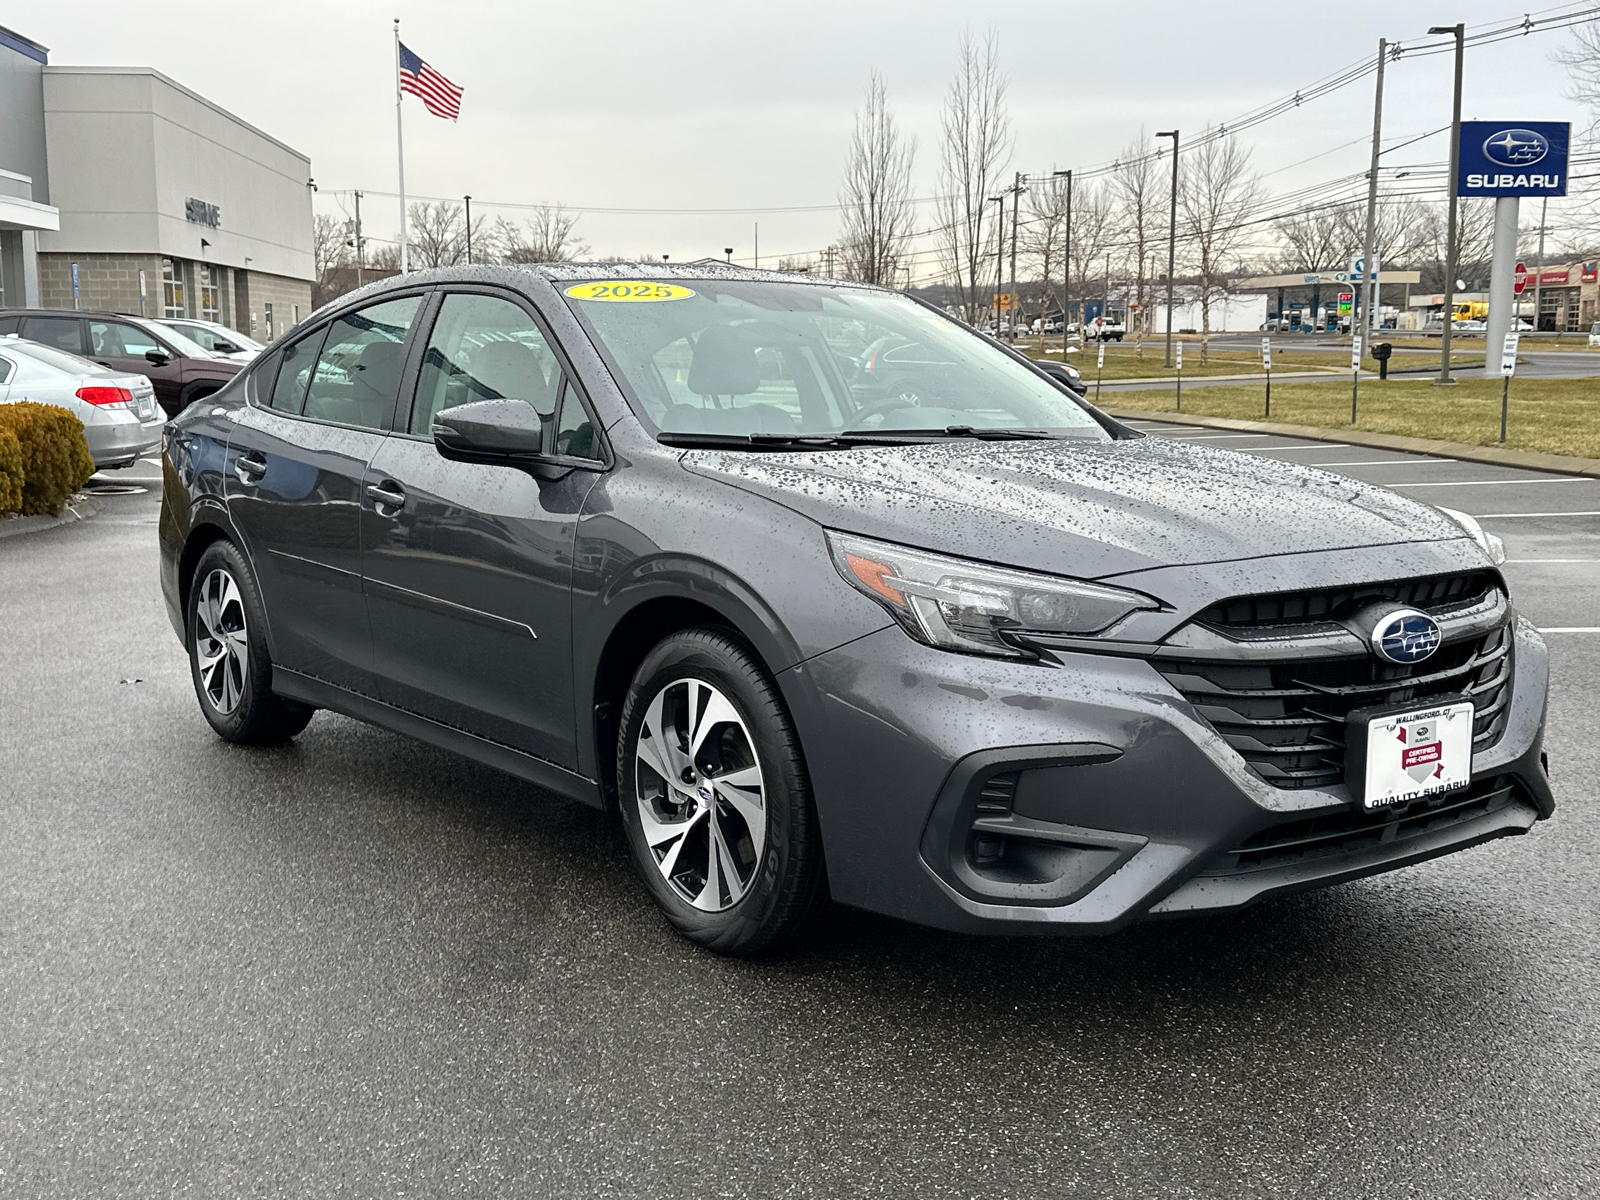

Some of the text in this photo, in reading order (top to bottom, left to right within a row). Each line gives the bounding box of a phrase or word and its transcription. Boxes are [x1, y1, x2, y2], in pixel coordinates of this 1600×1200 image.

[1466, 174, 1559, 188] SUBARU
[591, 286, 672, 298] 2025
[1443, 708, 1452, 716] CT
[1408, 746, 1436, 757] CERTIFIED
[1405, 752, 1439, 764] PRE-OWNED
[1371, 780, 1467, 808] QUALITY SUBARU
[764, 849, 779, 892] GT
